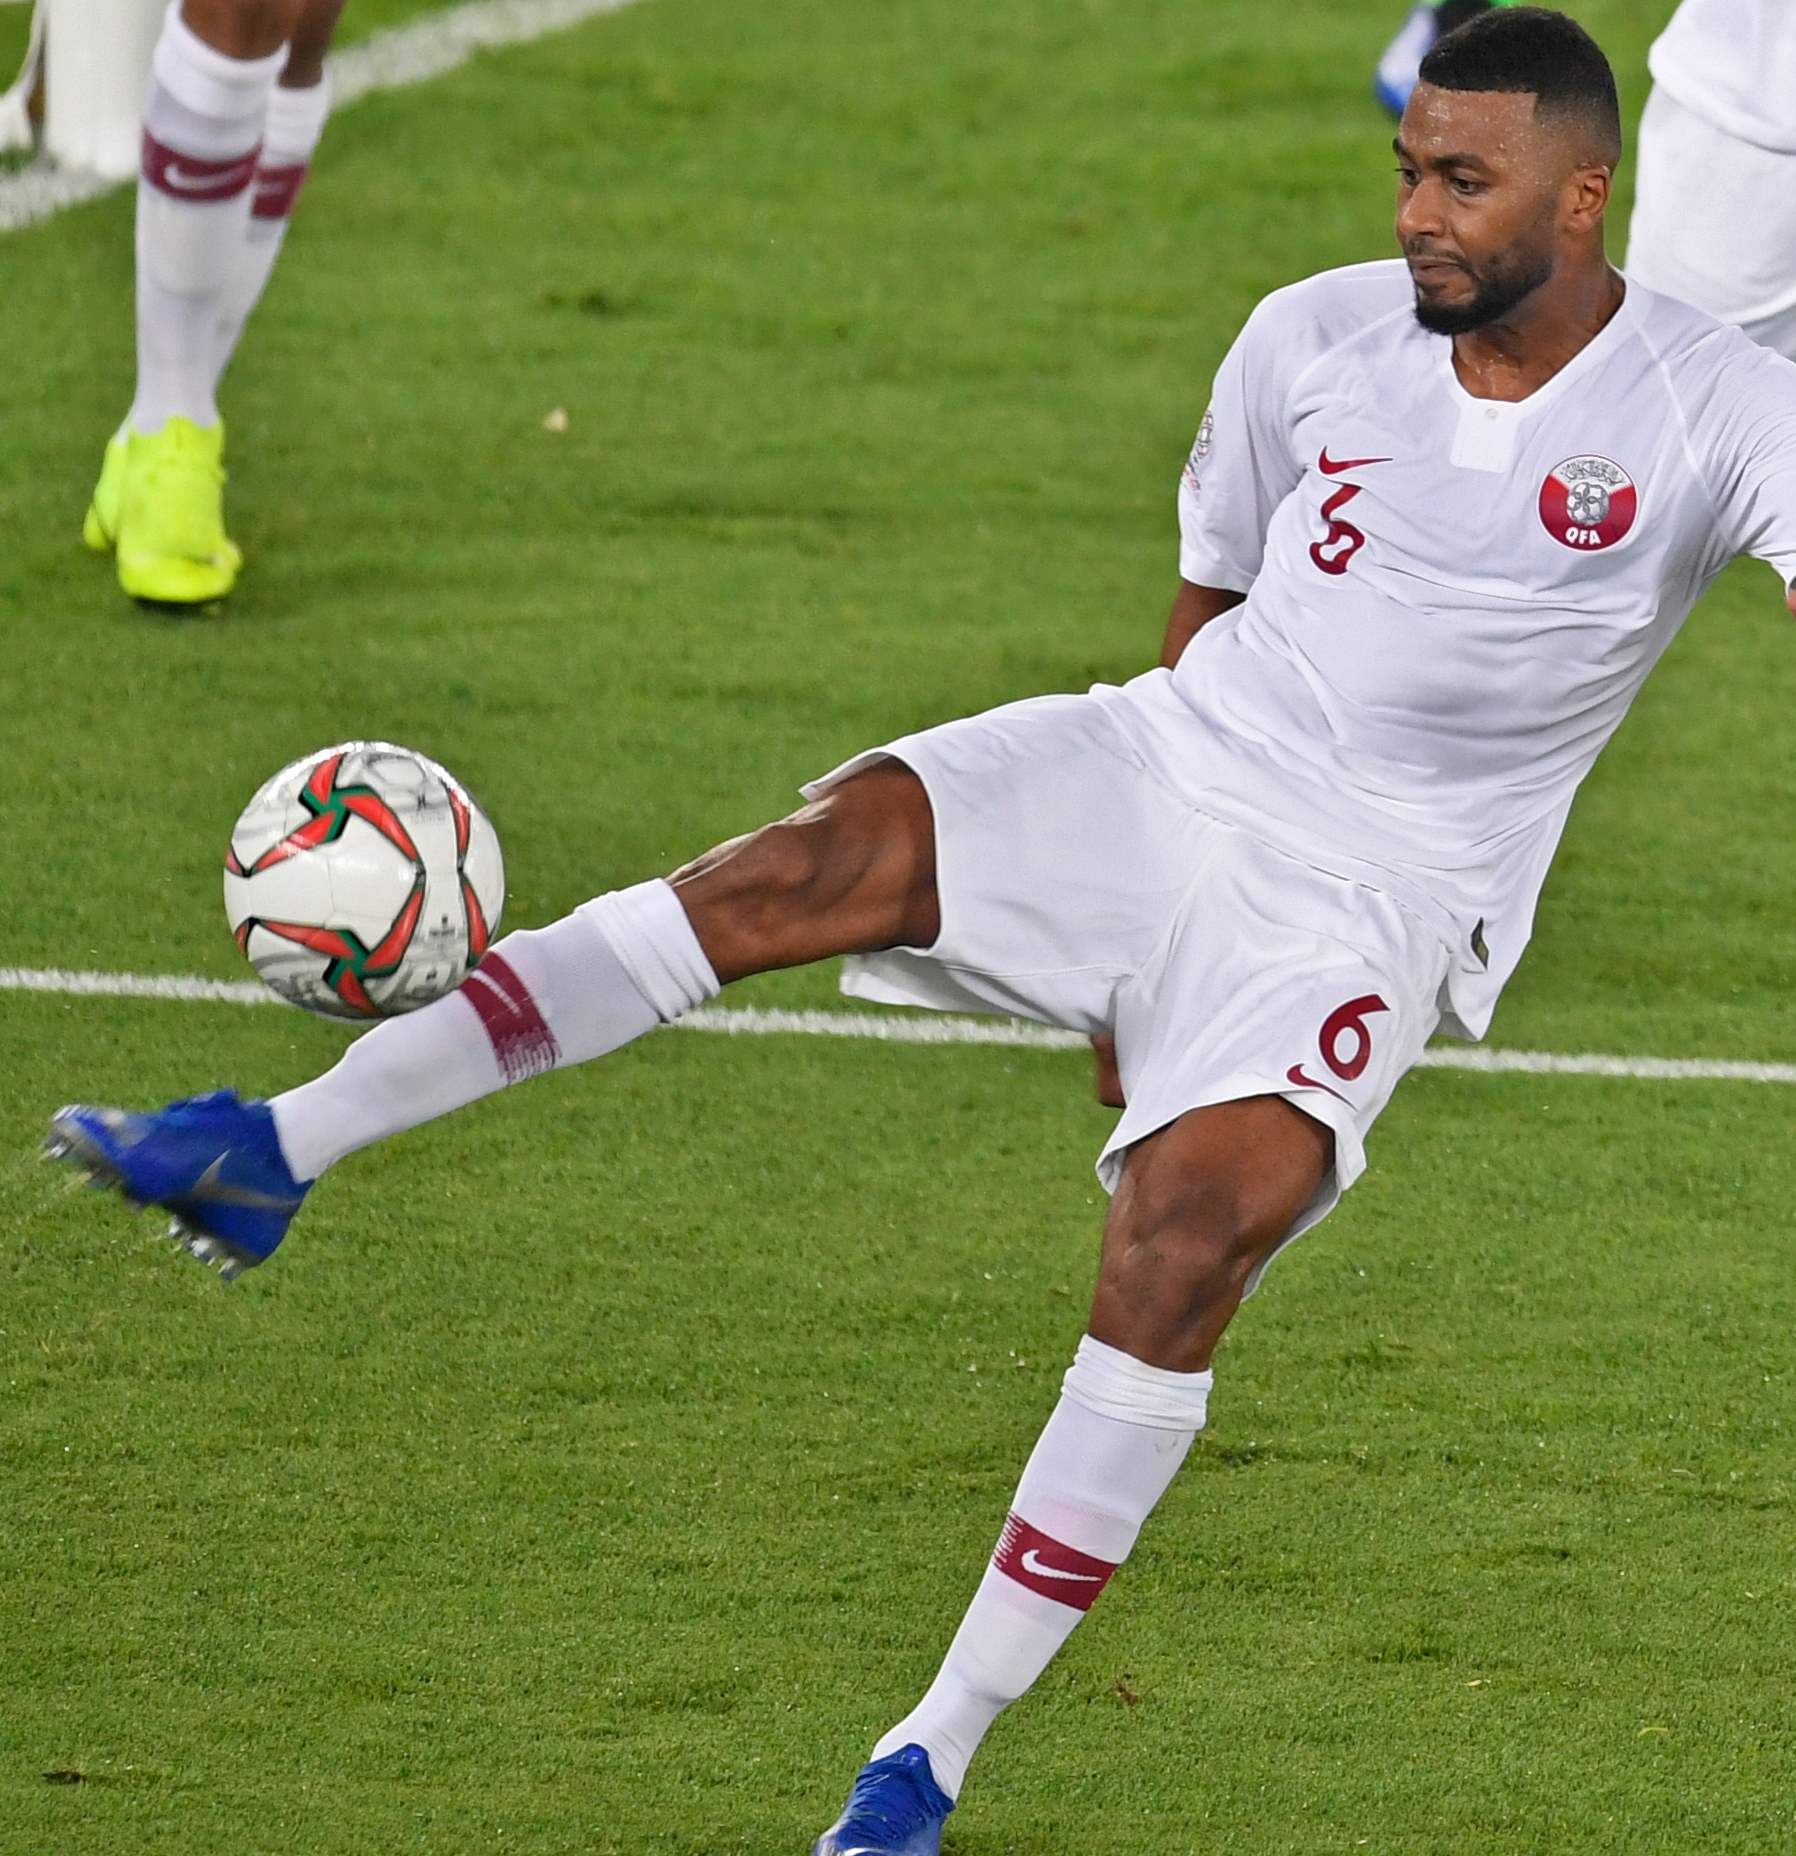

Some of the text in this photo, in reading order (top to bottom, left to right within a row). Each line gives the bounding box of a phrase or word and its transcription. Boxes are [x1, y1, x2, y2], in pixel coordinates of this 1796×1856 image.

[1309, 482, 1365, 575] 6
[1565, 526, 1601, 545] QFA
[1318, 993, 1391, 1081] 6
